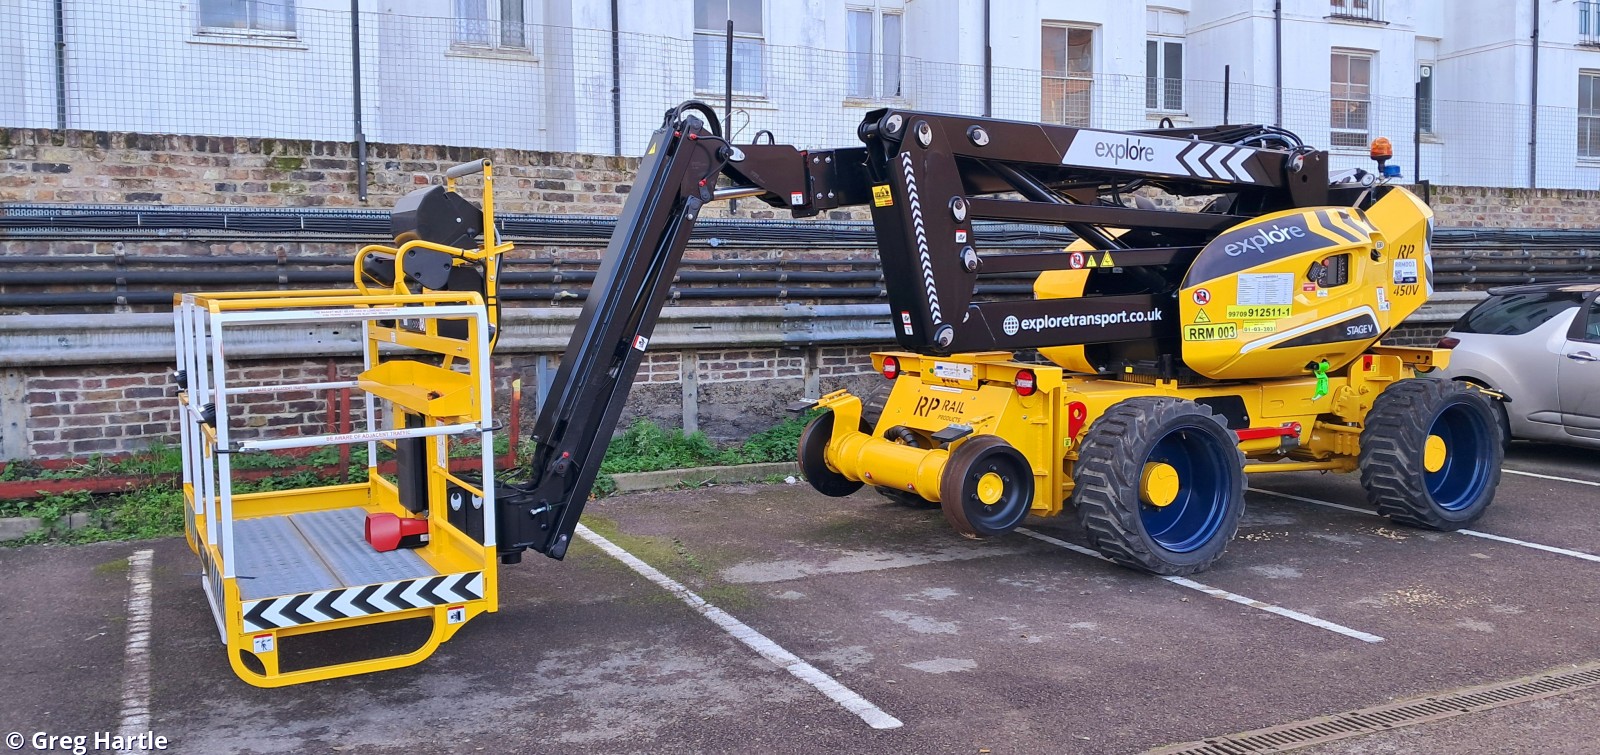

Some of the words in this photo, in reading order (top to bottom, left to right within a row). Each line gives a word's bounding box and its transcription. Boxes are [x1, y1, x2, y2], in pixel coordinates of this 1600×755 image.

[1095, 137, 1154, 165] explore
[1224, 224, 1306, 257] explore
[1397, 244, 1415, 259] RP
[1393, 284, 1420, 297] 450V
[1020, 307, 1162, 333] exploretransport.co.uk
[1189, 327, 1214, 340] RRM
[1217, 326, 1235, 339] 003
[1346, 325, 1368, 336] STAGE
[1368, 324, 1374, 333] V
[913, 395, 940, 417] RP
[941, 399, 964, 414] RAIL
[937, 414, 961, 423] PRODUCTS
[362, 431, 389, 439] ADJACENT
[390, 429, 411, 437] TRAFFIC
